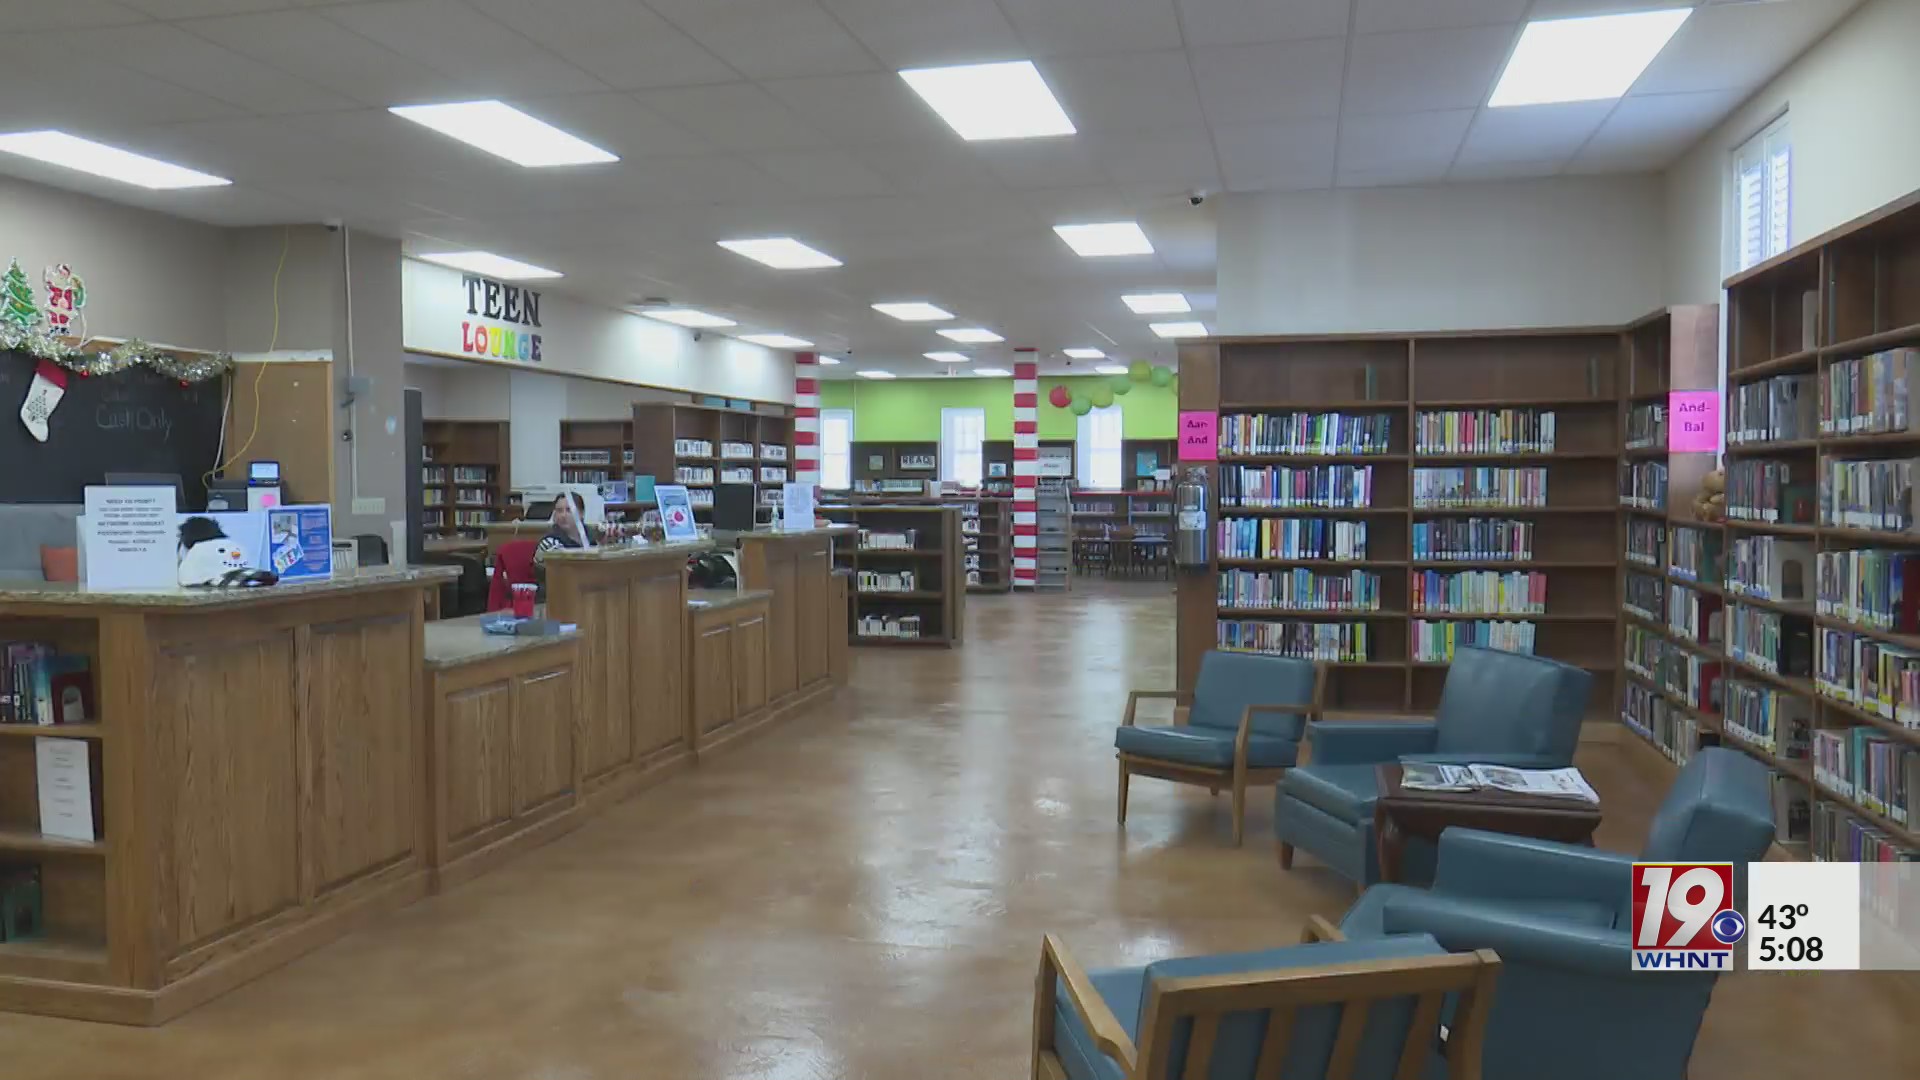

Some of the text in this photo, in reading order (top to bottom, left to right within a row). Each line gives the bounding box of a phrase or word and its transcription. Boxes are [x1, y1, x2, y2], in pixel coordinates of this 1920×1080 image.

[462, 275, 542, 327] TEEN
[462, 321, 542, 361] LOUNGE
[1679, 402, 1711, 412] And-
[1684, 421, 1704, 432] Bal
[1187, 435, 1208, 444] And
